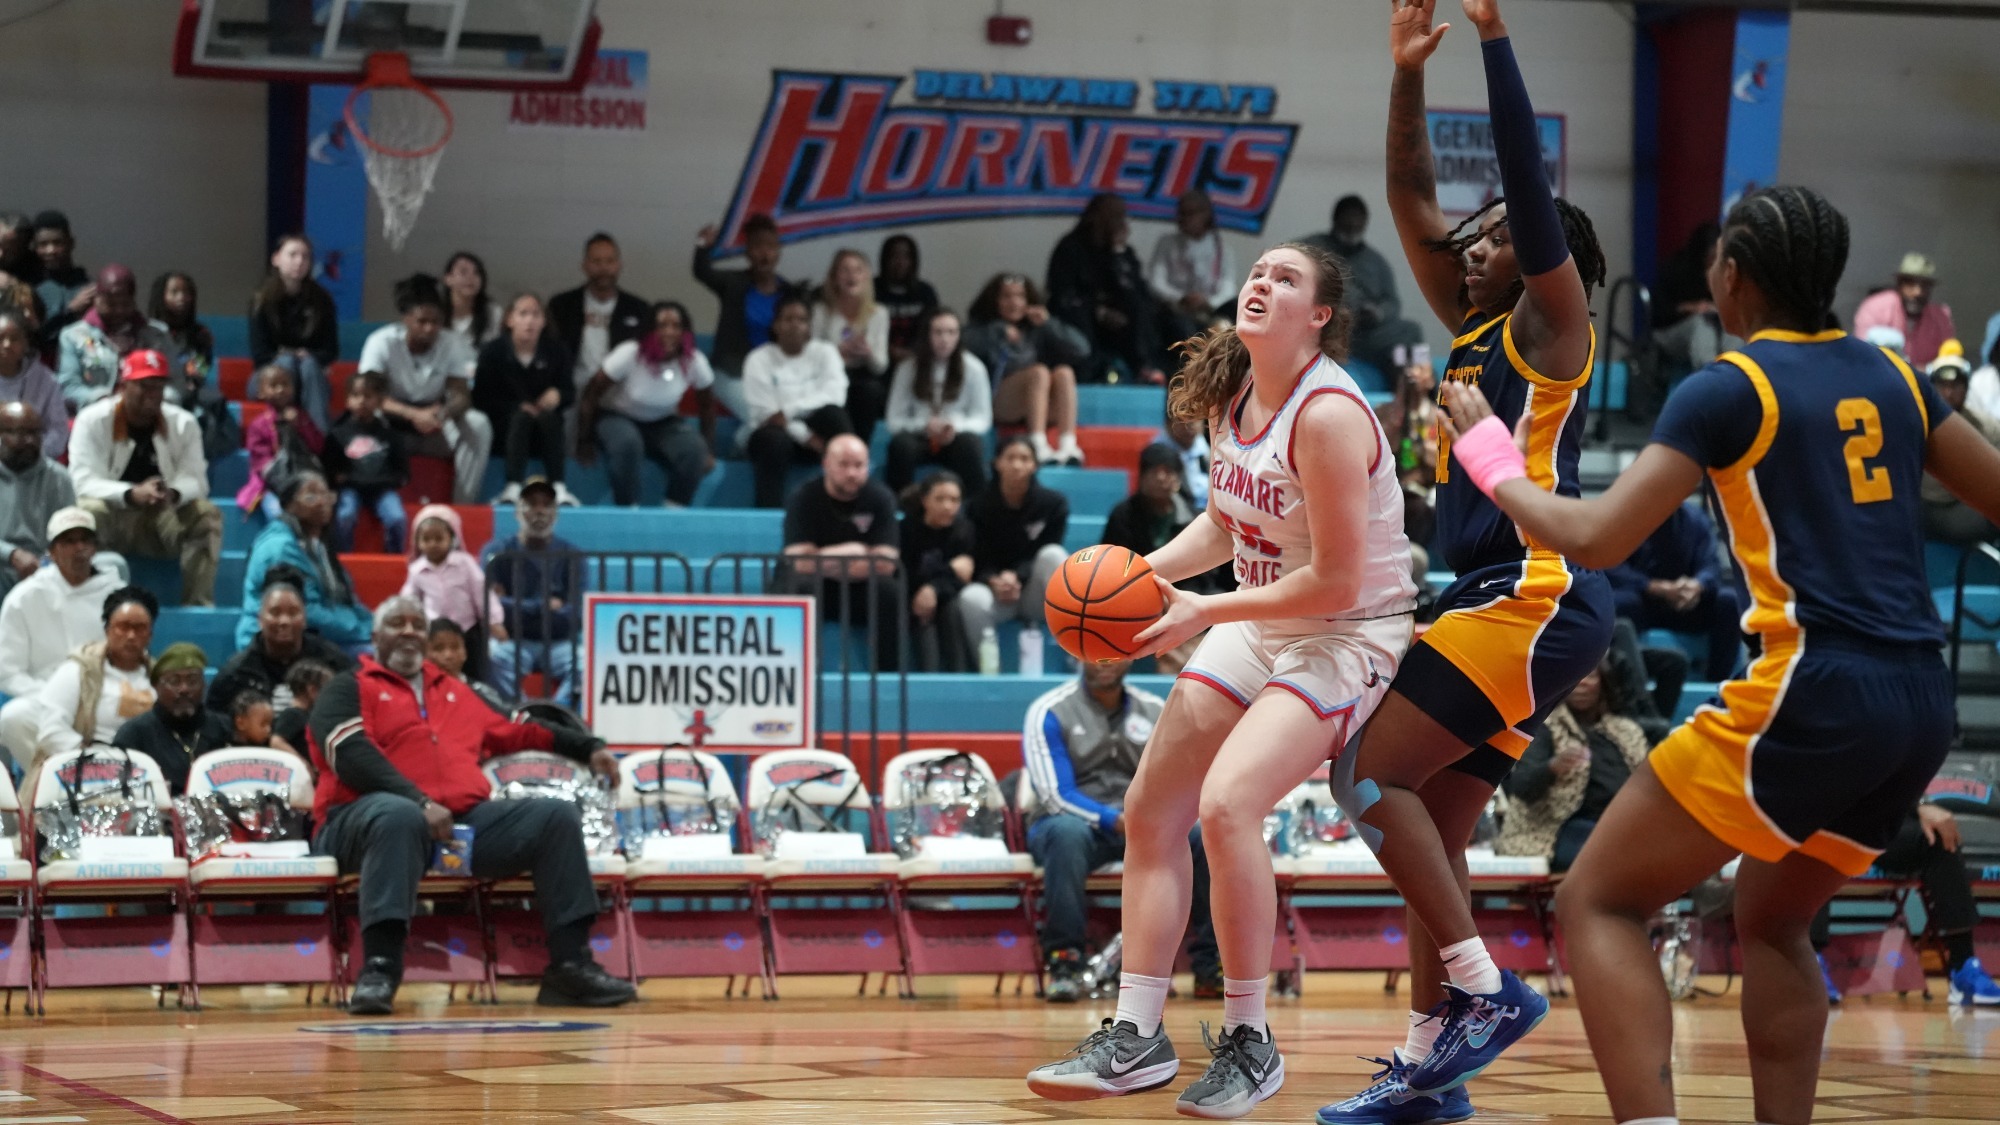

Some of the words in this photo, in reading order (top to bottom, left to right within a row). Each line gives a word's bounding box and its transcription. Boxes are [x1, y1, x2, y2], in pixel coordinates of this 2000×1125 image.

[509, 92, 646, 130] ADMISSION
[914, 70, 1138, 107] DELAWARE
[1154, 81, 1277, 114] STATE
[724, 75, 1293, 250] HORNETS
[1835, 397, 1893, 504] 2
[617, 613, 784, 656] GENERAL
[600, 664, 797, 706] ADMISSION
[76, 863, 163, 878] ATHLETICS
[233, 862, 317, 876] ATHLETICS
